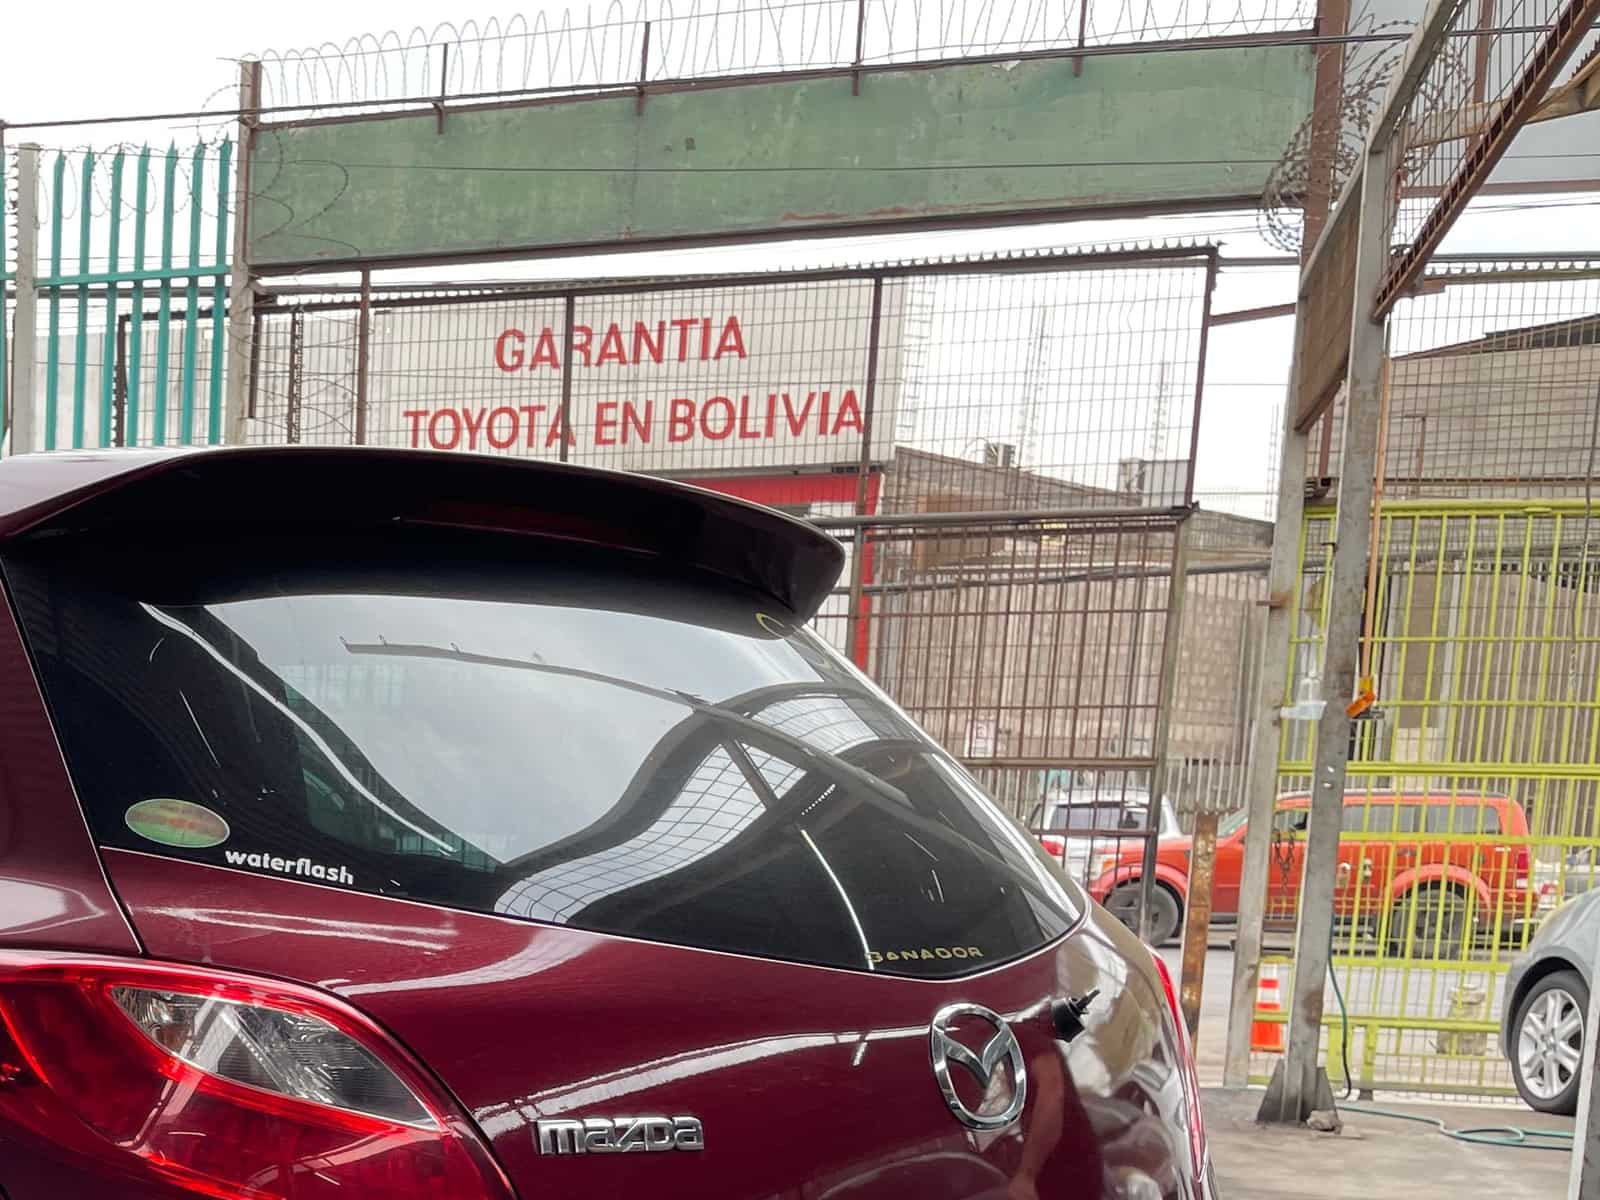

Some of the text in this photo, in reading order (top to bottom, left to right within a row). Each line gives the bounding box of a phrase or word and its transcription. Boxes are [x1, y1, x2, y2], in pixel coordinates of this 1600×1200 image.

[495, 316, 747, 372] GARANTIA
[403, 389, 864, 450] TOYOTA EN BOLIVIA
[224, 850, 355, 885] waterflash
